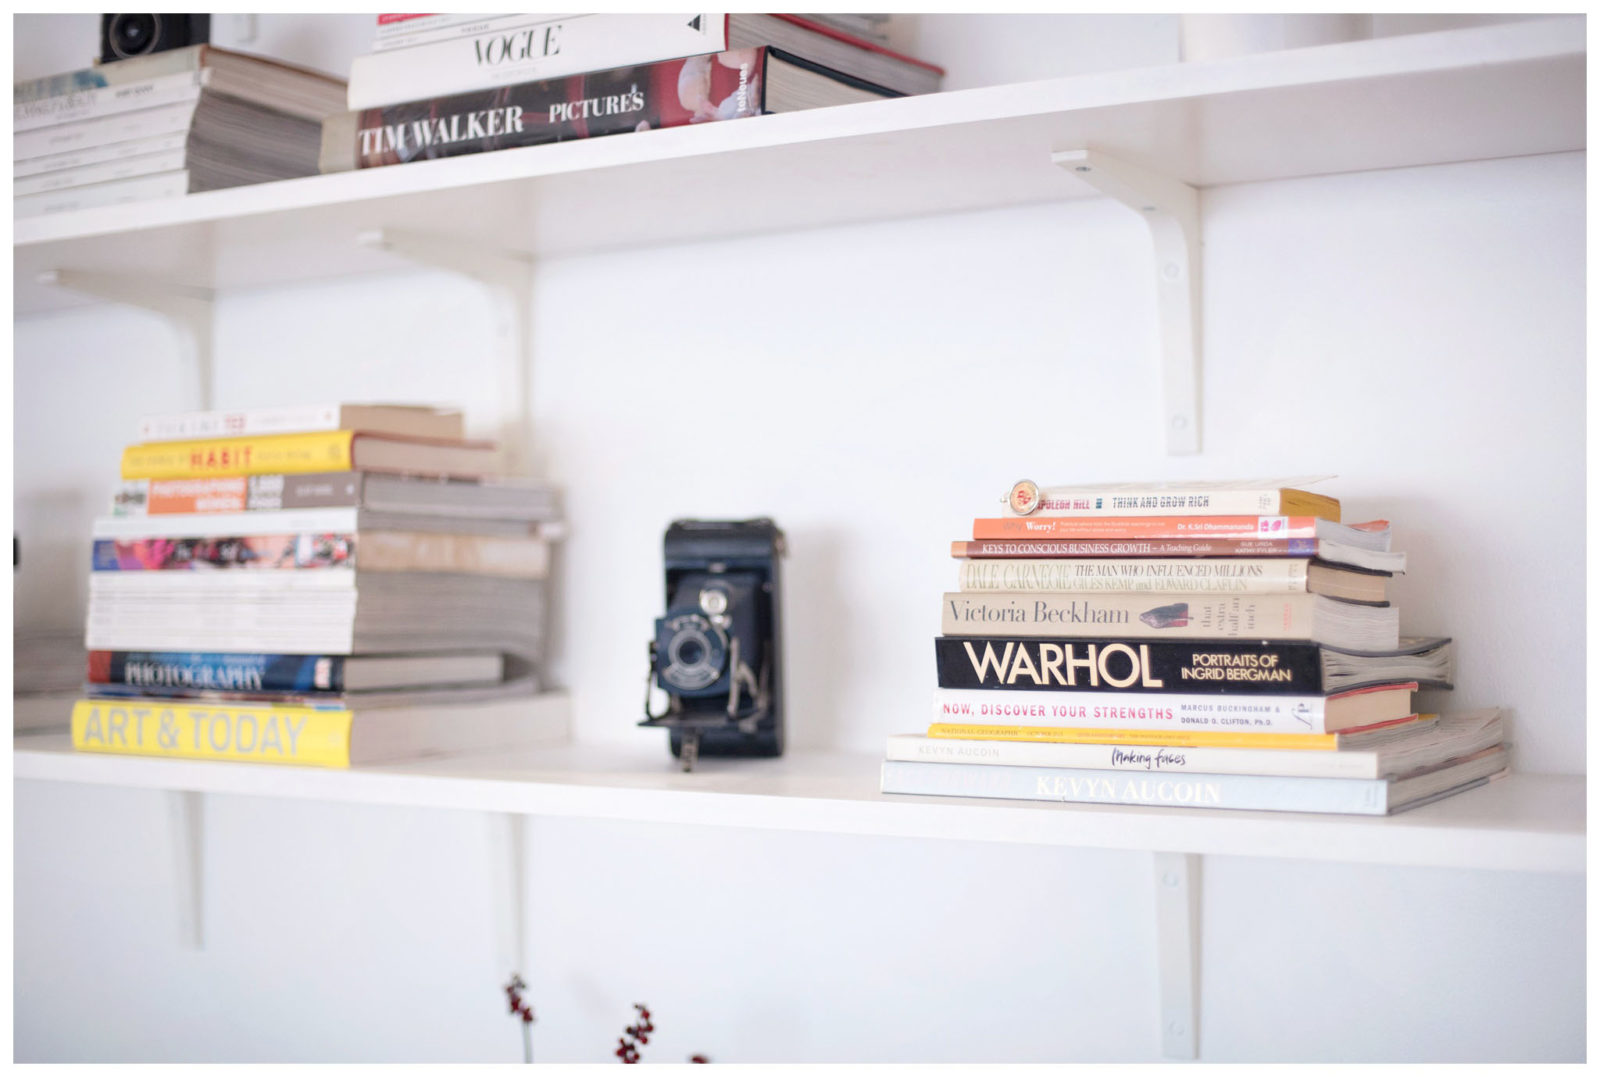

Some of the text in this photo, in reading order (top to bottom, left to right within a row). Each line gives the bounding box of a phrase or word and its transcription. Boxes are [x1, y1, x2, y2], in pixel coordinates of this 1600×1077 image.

[474, 24, 562, 68] VOGUE
[358, 92, 645, 157] TIM WALKER PICTURES
[189, 446, 253, 469] HABIT
[1036, 498, 1091, 512] APOLEON HILL
[1112, 495, 1210, 509] THINK AND GROW RICH
[1025, 520, 1057, 534] Worry!
[1177, 523, 1186, 531] Dr.
[982, 543, 1003, 554] KEYS
[1004, 543, 1015, 554] TO
[1016, 543, 1067, 554] CONSCIOUS
[1068, 543, 1109, 553] BUSINESS
[1110, 543, 1150, 553] GROWTH
[1166, 544, 1192, 553] Teaching
[1192, 543, 1212, 551] Guide
[966, 563, 1072, 591] DALE CARNEGIE
[1074, 564, 1263, 577] THE MAN WHO INFLUENCED MILLIONS
[1073, 578, 1248, 591] GILES KEMP and EDWARD CLAFLIN
[949, 600, 1129, 624] Victoria Beckham
[1201, 606, 1212, 628] that
[1217, 602, 1226, 631] extra
[963, 641, 1164, 688] WARHOL
[1192, 653, 1279, 668] PORTRAITS OF
[124, 661, 265, 690] PHOTOGRAPHY
[1181, 667, 1292, 682] INGRID BERGMAN
[943, 703, 1174, 720] NOW, DISCOVER YOUR STRENGTHS
[1181, 704, 1281, 714] MARCUS BUCKINGHAM &
[1181, 717, 1209, 726] DONALD
[1221, 717, 1253, 727] CLIFTON,
[83, 708, 309, 756] ART & TODAY
[940, 727, 975, 735] NATIONAL
[977, 728, 1019, 737] GEOGRAPHIC
[918, 745, 1186, 769] KEVYN AUCOIN Making faces
[1035, 775, 1116, 800] KEVYN
[1123, 779, 1222, 803] AUCOIN
